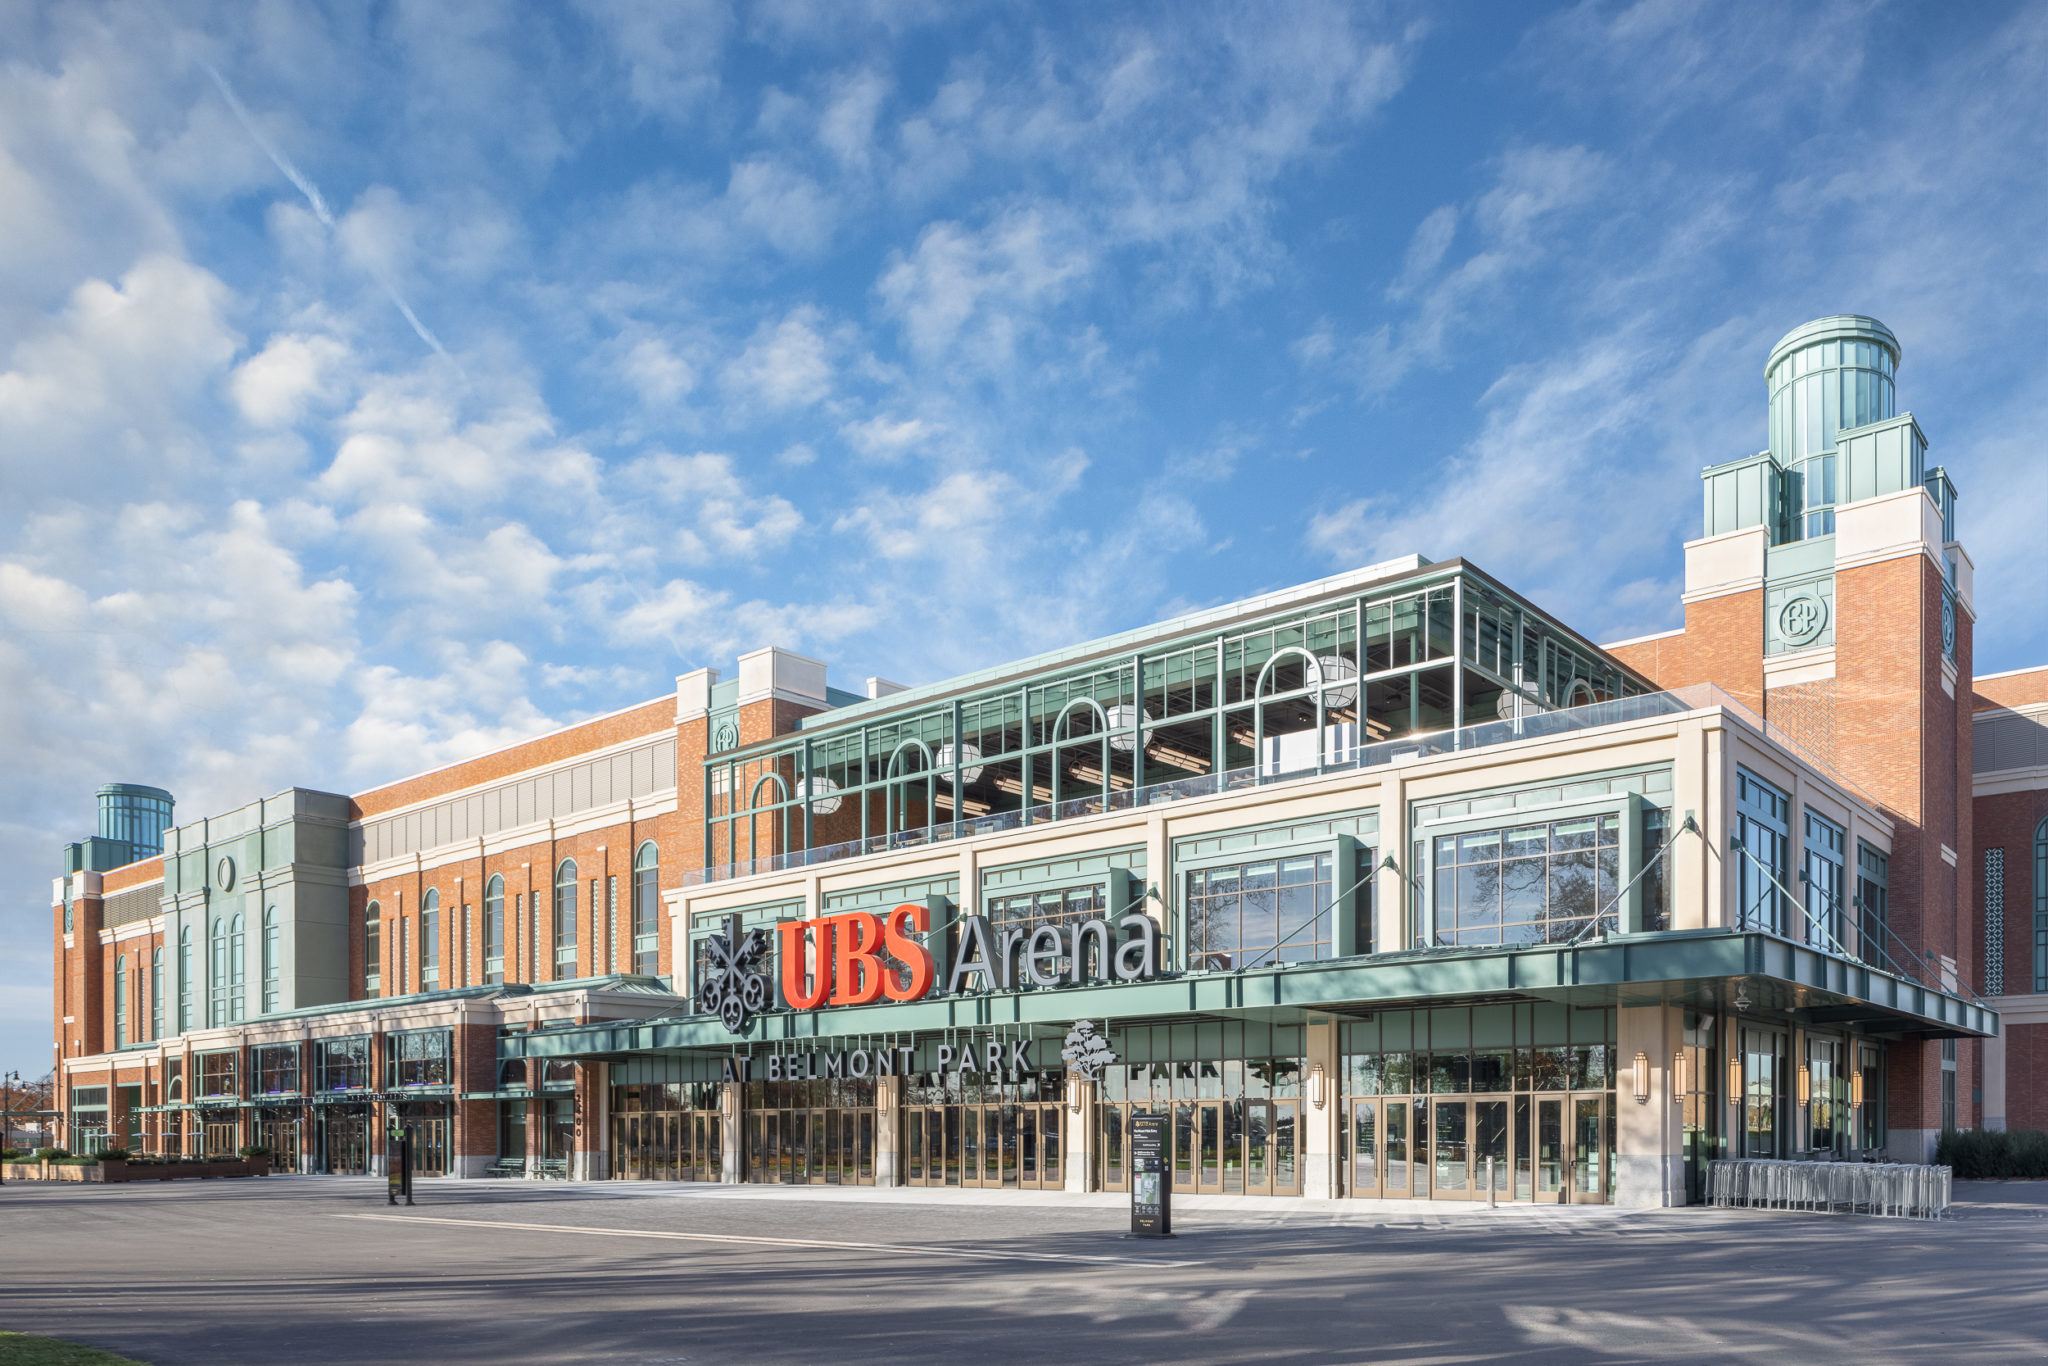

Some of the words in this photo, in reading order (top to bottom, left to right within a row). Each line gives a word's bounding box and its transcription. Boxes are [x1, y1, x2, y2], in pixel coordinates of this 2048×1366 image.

[777, 904, 934, 1010] UBS
[949, 914, 1162, 994] Arena
[722, 1056, 752, 1083] AT
[768, 1046, 915, 1082] BELMONT
[938, 1040, 1032, 1075] PARK
